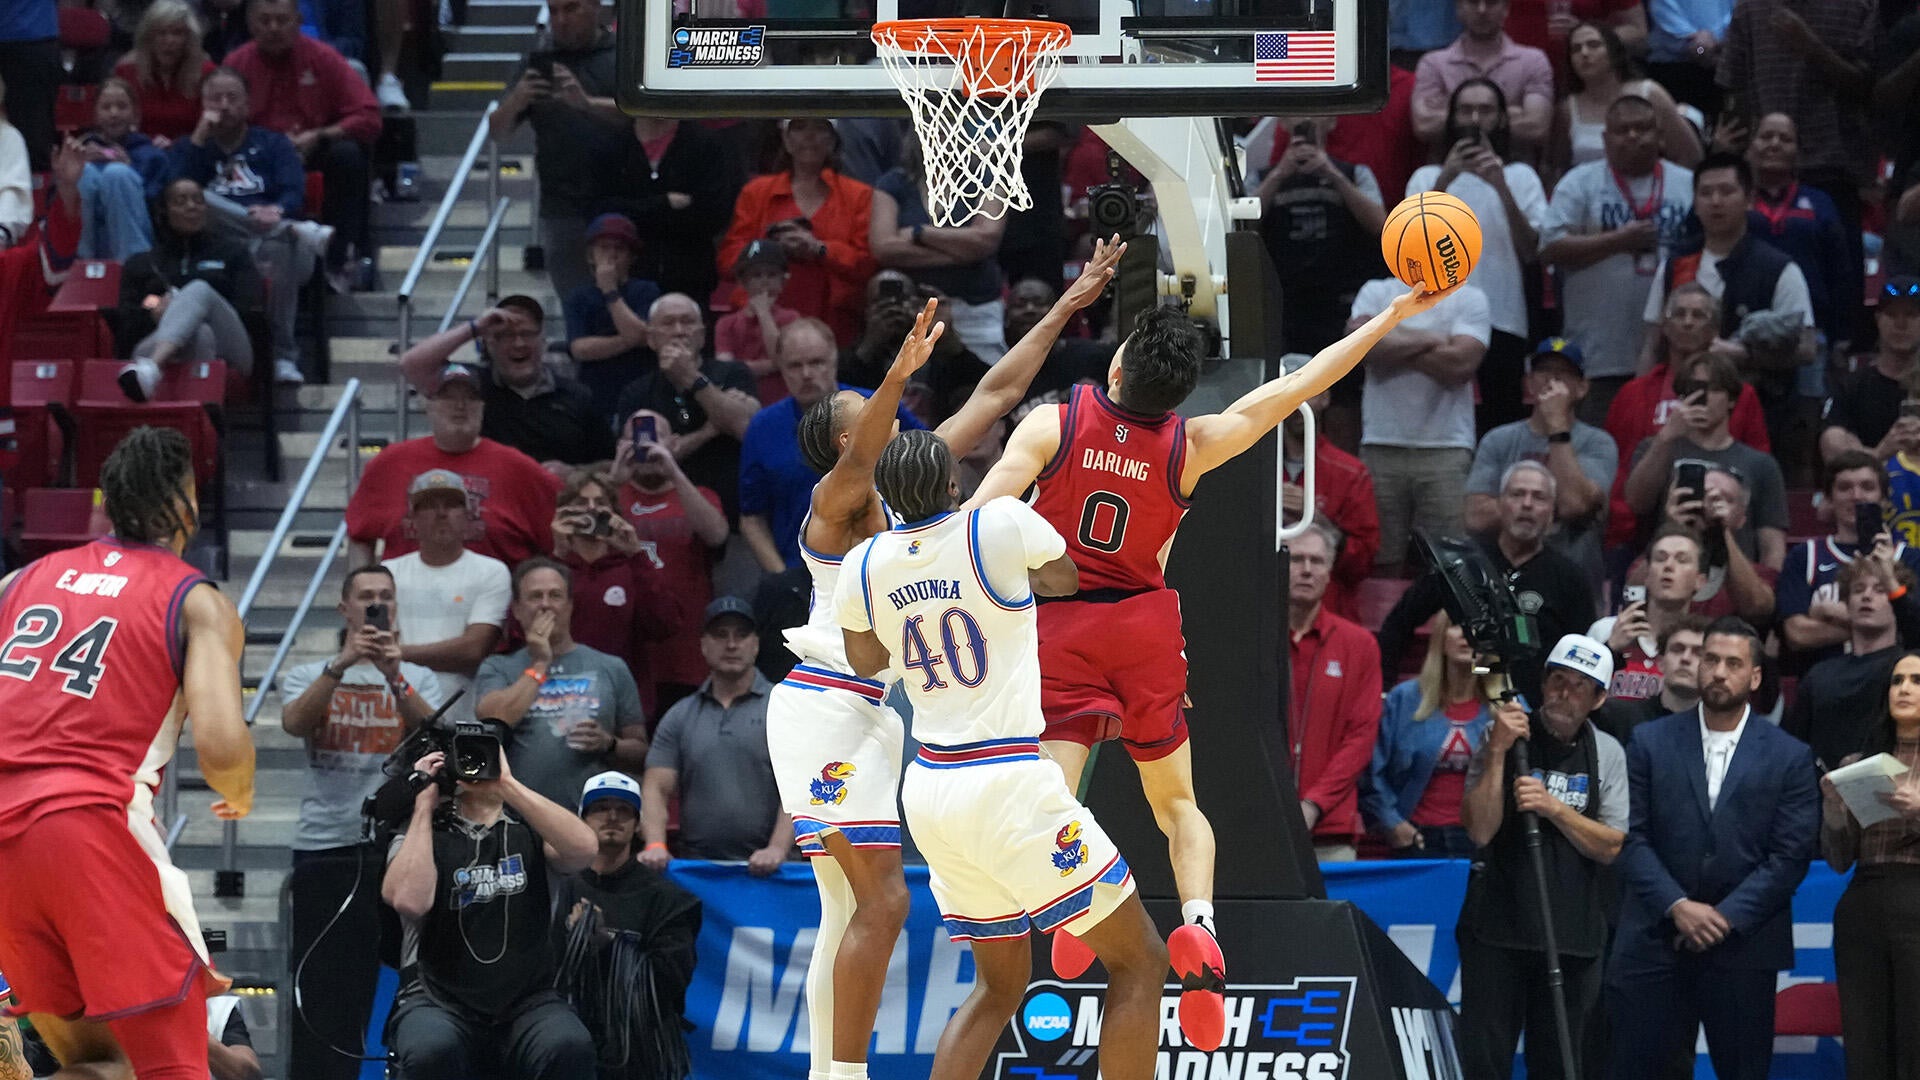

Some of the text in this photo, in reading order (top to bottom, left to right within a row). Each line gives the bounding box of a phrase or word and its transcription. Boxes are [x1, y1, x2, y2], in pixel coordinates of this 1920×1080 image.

[689, 31, 738, 46] MARCH
[694, 46, 761, 61] MADNESS
[1082, 447, 1151, 482] DARLING
[1077, 489, 1131, 554] 0
[887, 579, 963, 611] BIDUNGA
[0, 603, 119, 700] 24
[902, 606, 989, 693] 40
[821, 785, 835, 795] KU
[1027, 1015, 1071, 1030] NCAA
[1072, 995, 1256, 1048] MRH
